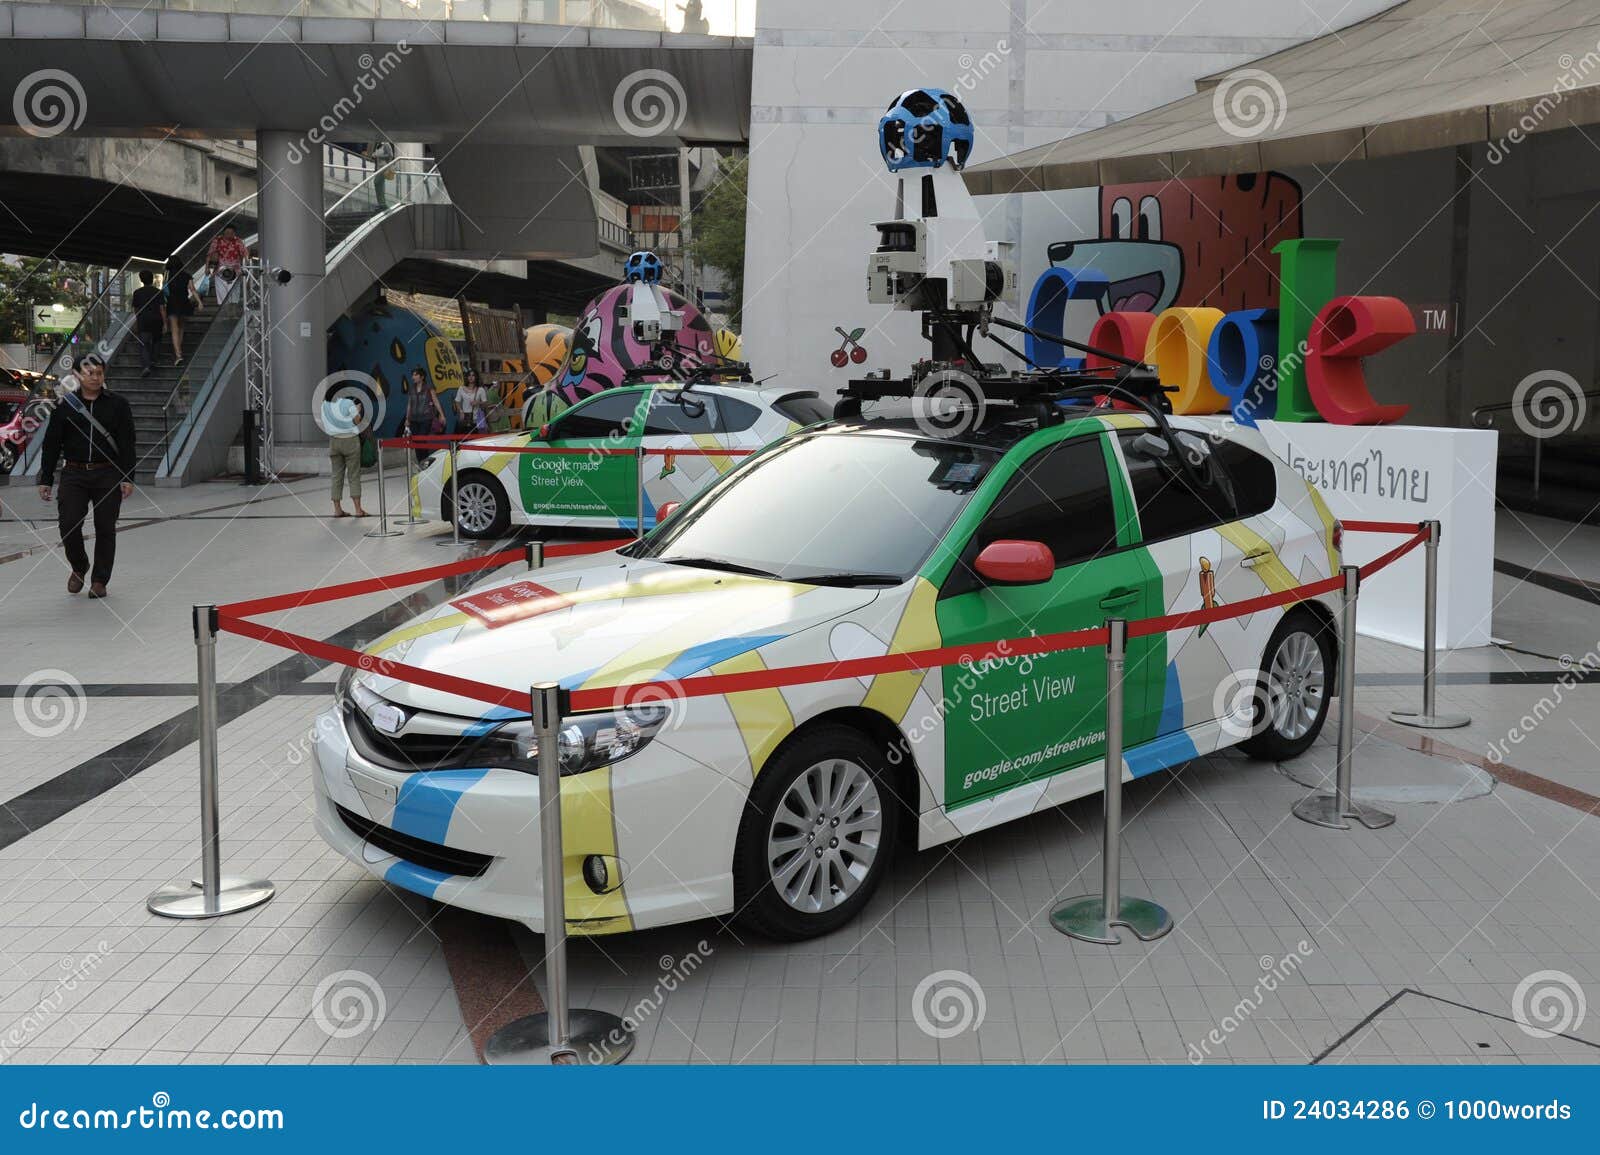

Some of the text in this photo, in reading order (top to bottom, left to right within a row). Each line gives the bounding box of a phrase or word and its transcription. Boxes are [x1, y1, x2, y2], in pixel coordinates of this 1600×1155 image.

[1423, 309, 1447, 331] TM
[1024, 239, 1417, 428] Google
[531, 457, 600, 475] Google maps
[531, 474, 585, 488] Street View
[533, 502, 608, 511] google.com/streetview
[970, 675, 1077, 722] Street View
[963, 730, 1107, 789] google.com/streetview
